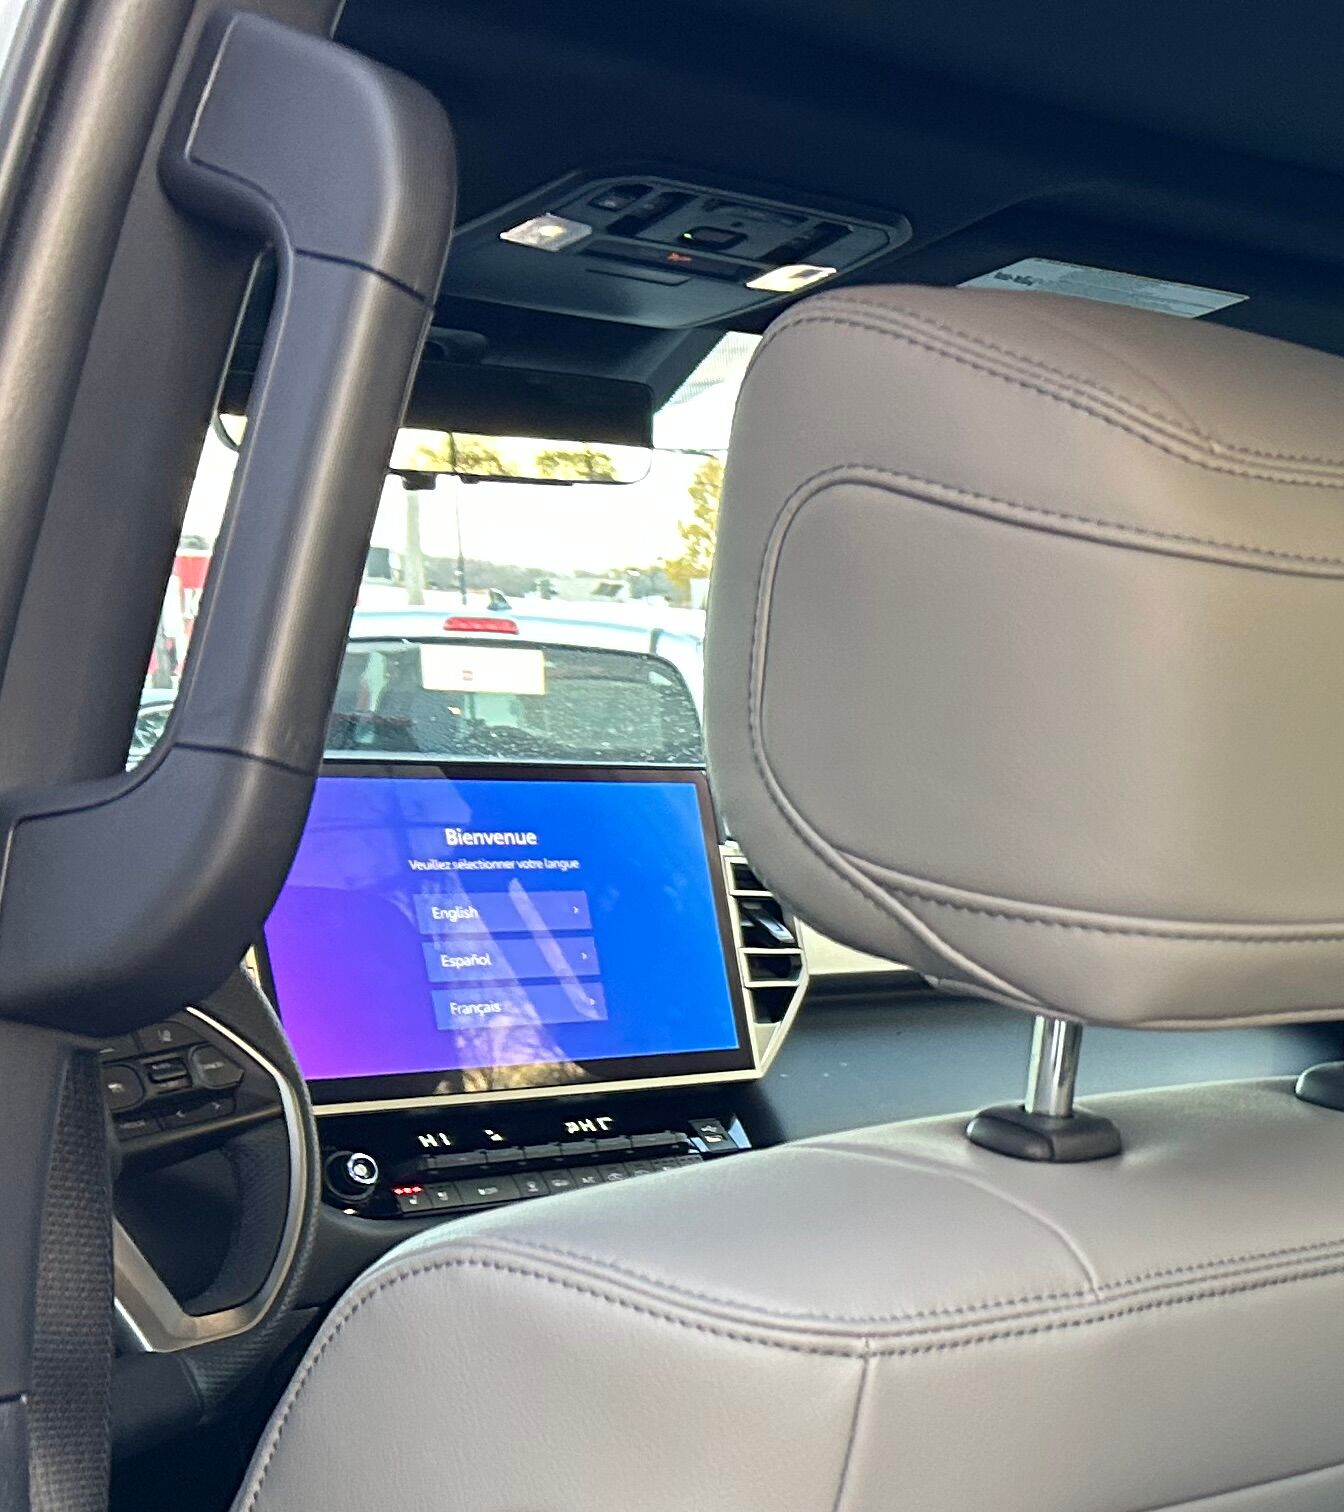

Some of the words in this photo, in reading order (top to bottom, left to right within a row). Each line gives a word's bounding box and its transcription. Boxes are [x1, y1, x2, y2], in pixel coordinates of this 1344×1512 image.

[444, 828, 538, 846] Bienvenue
[408, 858, 451, 871] Veuillez
[517, 857, 543, 870] votre
[544, 857, 581, 872] langue
[431, 906, 479, 923] English
[440, 953, 493, 970] Español
[450, 1001, 502, 1017] Français
